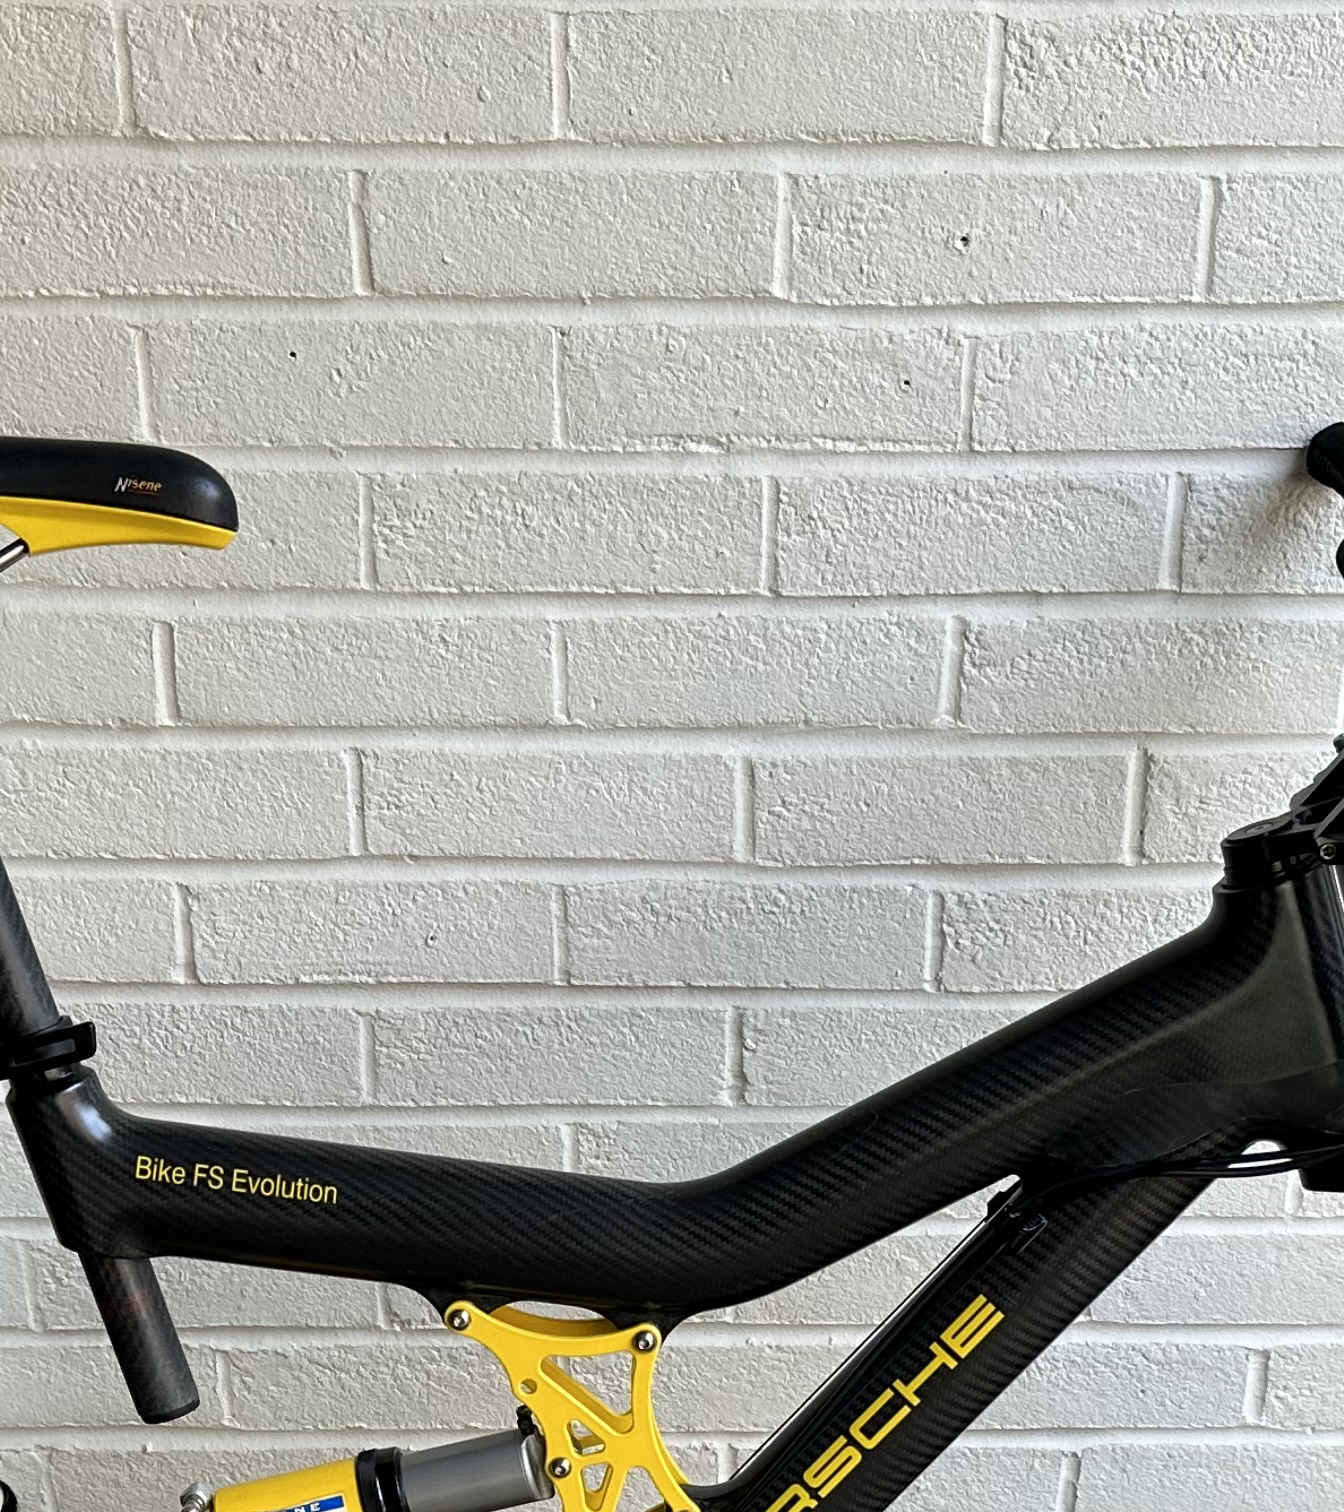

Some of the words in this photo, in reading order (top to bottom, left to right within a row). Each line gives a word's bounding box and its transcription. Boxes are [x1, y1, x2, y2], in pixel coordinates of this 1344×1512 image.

[135, 1155, 186, 1185] Bike
[193, 1163, 224, 1190] FS
[231, 1168, 338, 1205] Evolution
